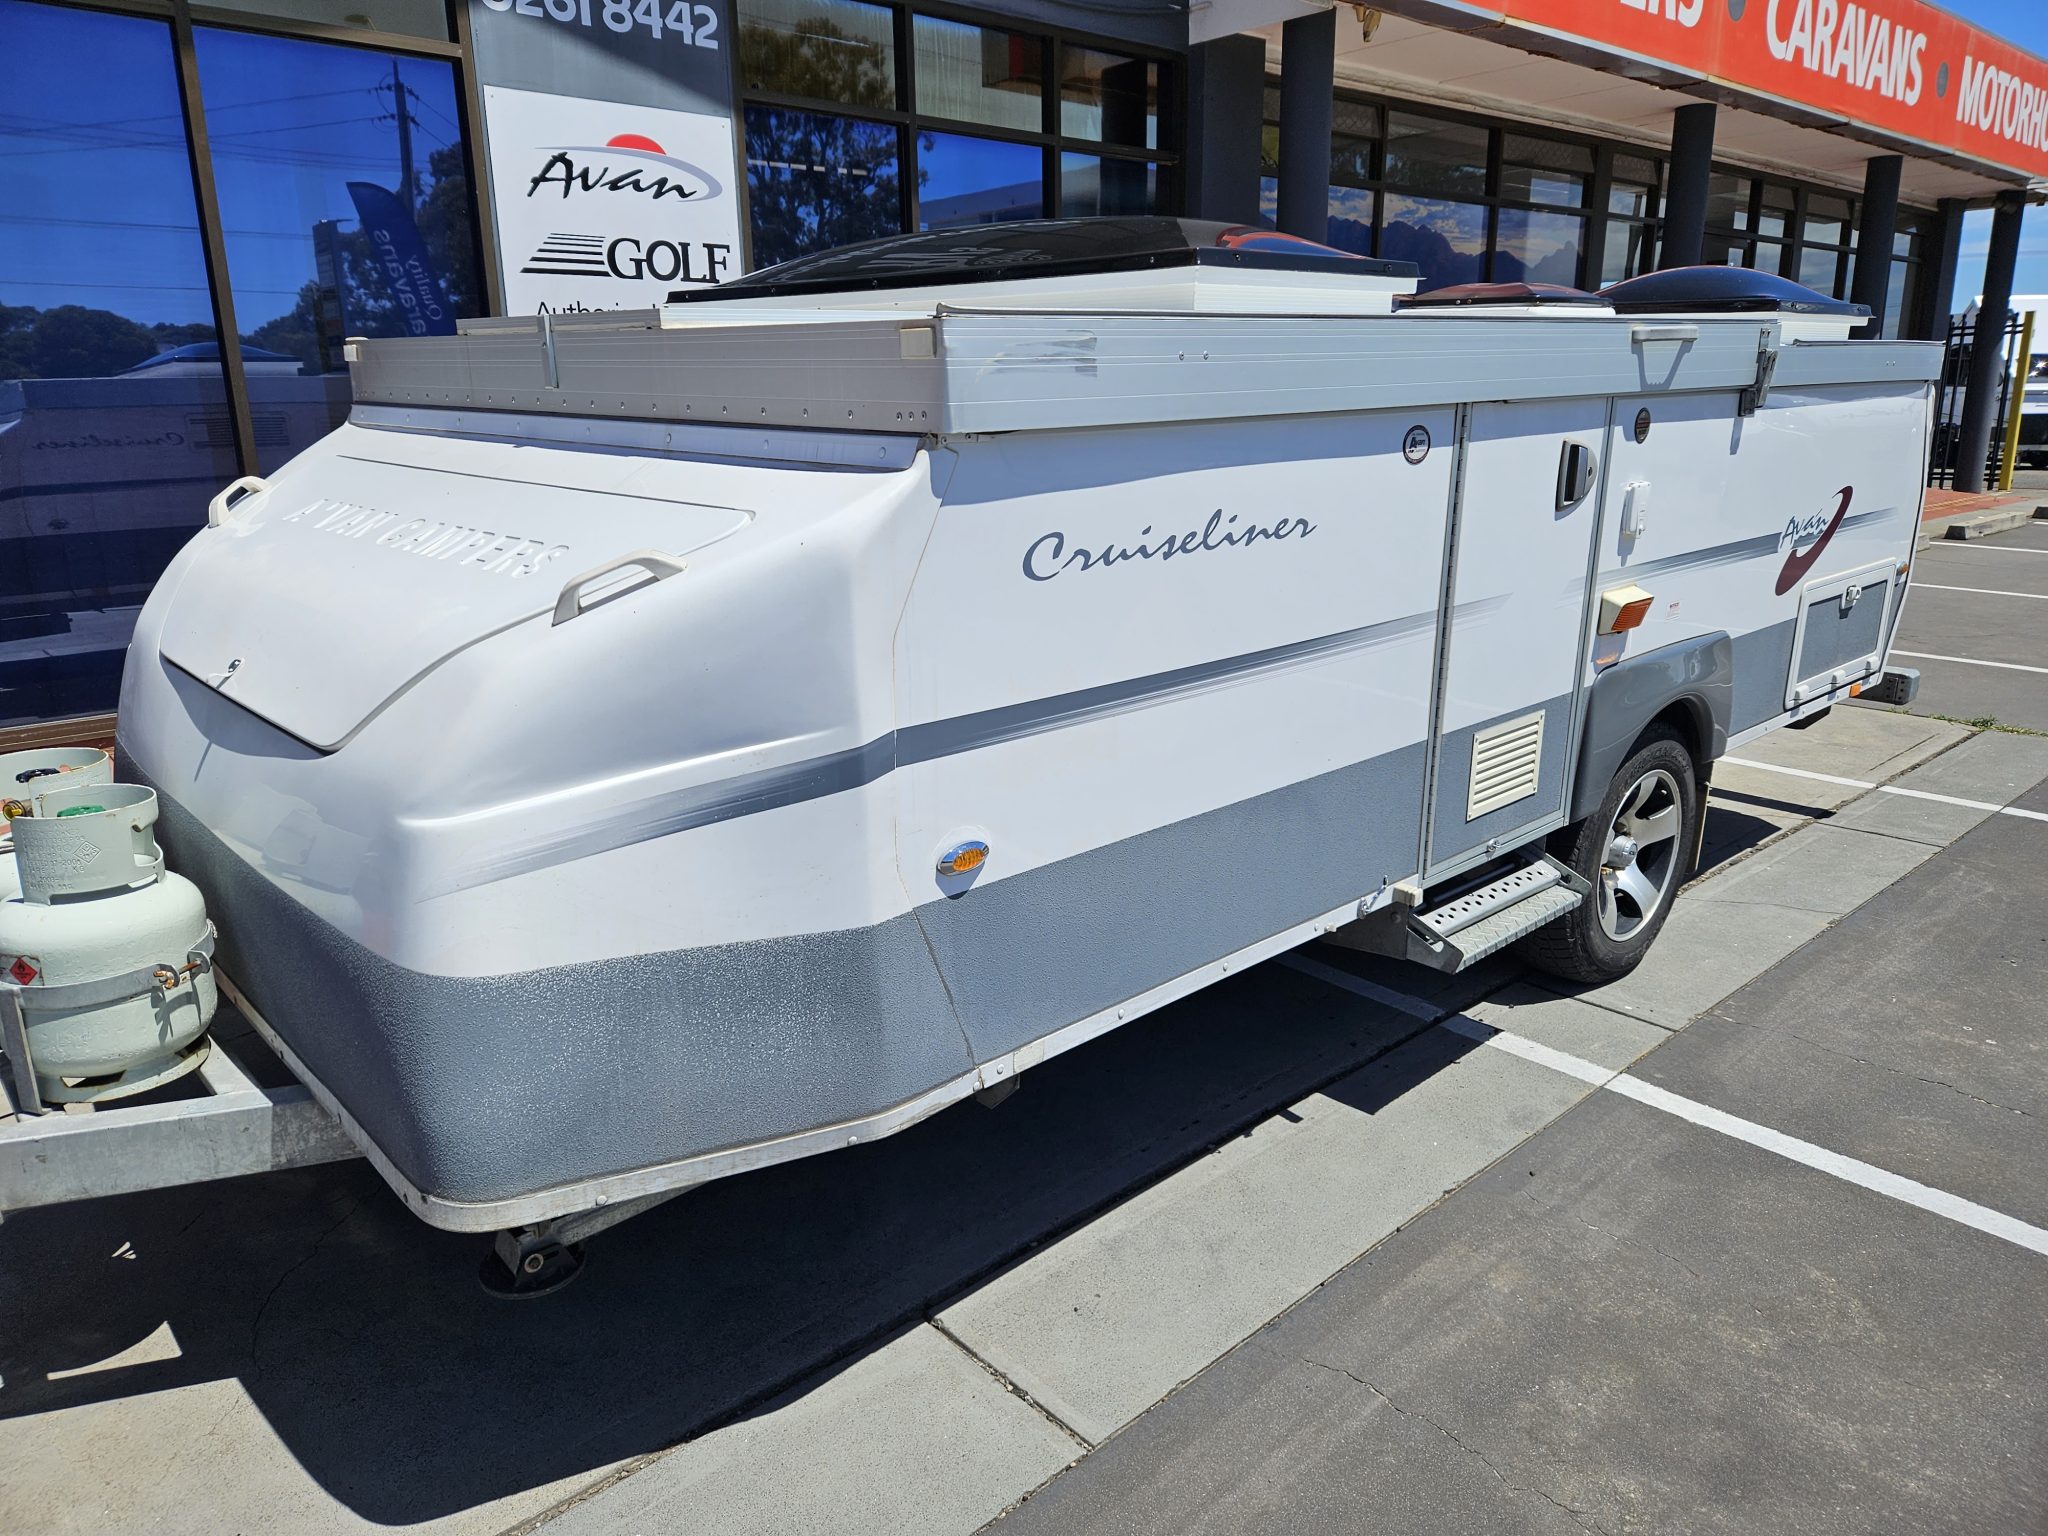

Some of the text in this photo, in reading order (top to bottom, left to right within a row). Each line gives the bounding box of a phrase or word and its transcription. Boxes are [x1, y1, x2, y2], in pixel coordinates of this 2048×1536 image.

[602, 0, 719, 50] 8442
[1766, 0, 1928, 107] CARAVANS
[527, 151, 698, 200] Avan
[606, 237, 731, 284] GOLF
[375, 518, 570, 579] CAMPERS
[1022, 508, 1318, 582] Cruiseliner
[1779, 509, 1830, 549] Avan
